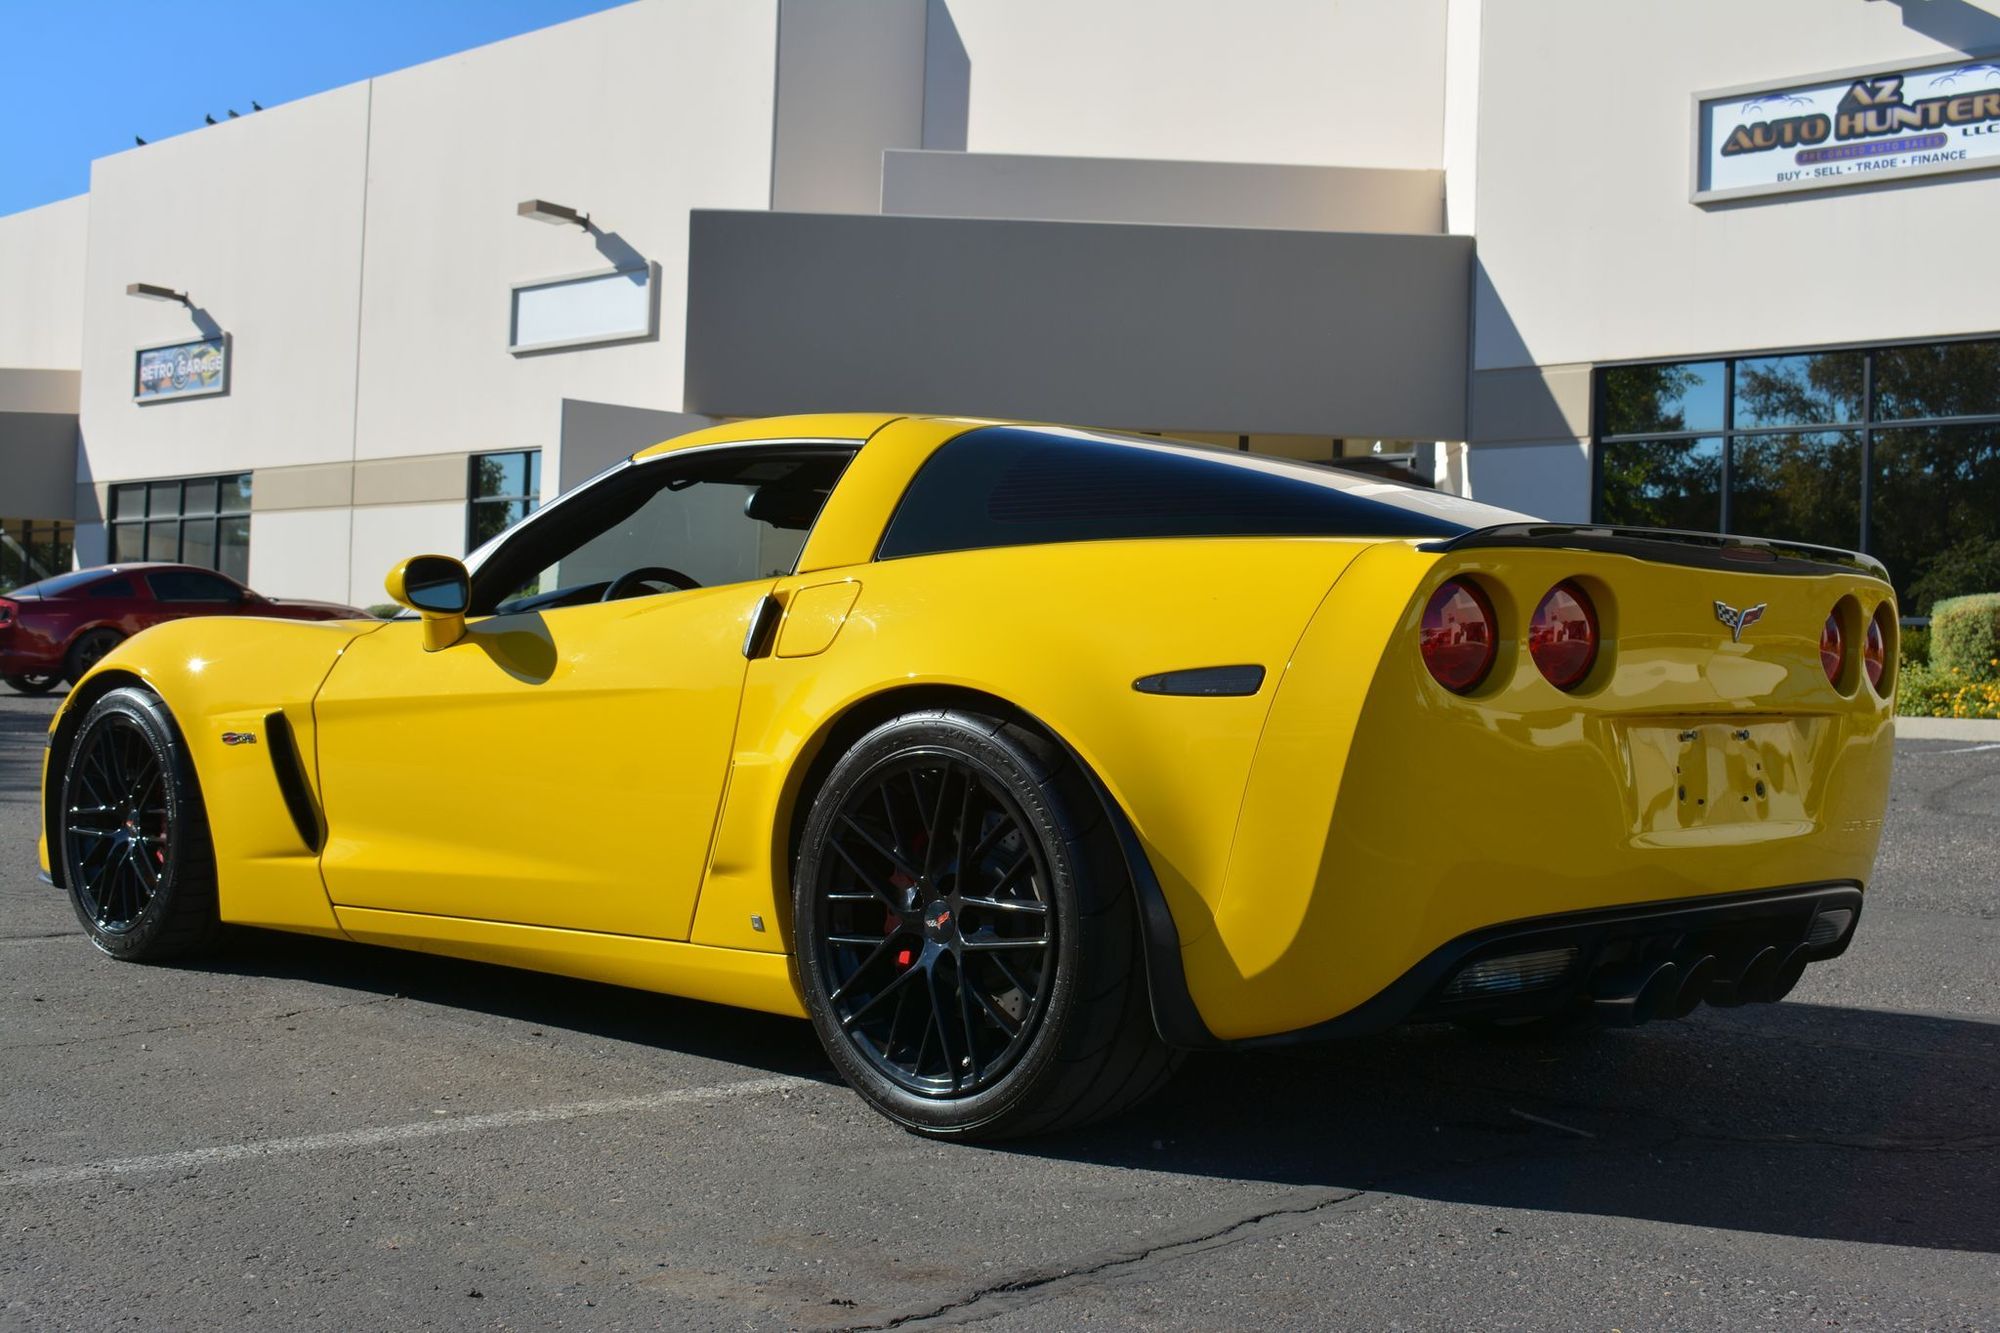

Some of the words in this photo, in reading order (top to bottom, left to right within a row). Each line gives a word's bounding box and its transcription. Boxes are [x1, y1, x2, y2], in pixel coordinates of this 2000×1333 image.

[1838, 77, 1902, 108] AZ
[1722, 116, 1830, 154] AUTO
[1962, 123, 2000, 136] LLC
[1871, 142, 1899, 154] AUTO
[1904, 136, 1941, 149] SALES
[1776, 170, 1801, 182] BUY
[1813, 166, 1843, 178] SELL
[1856, 158, 1898, 172] TRADE
[1911, 149, 1967, 165] FINANCE
[1373, 440, 1382, 453] 4
